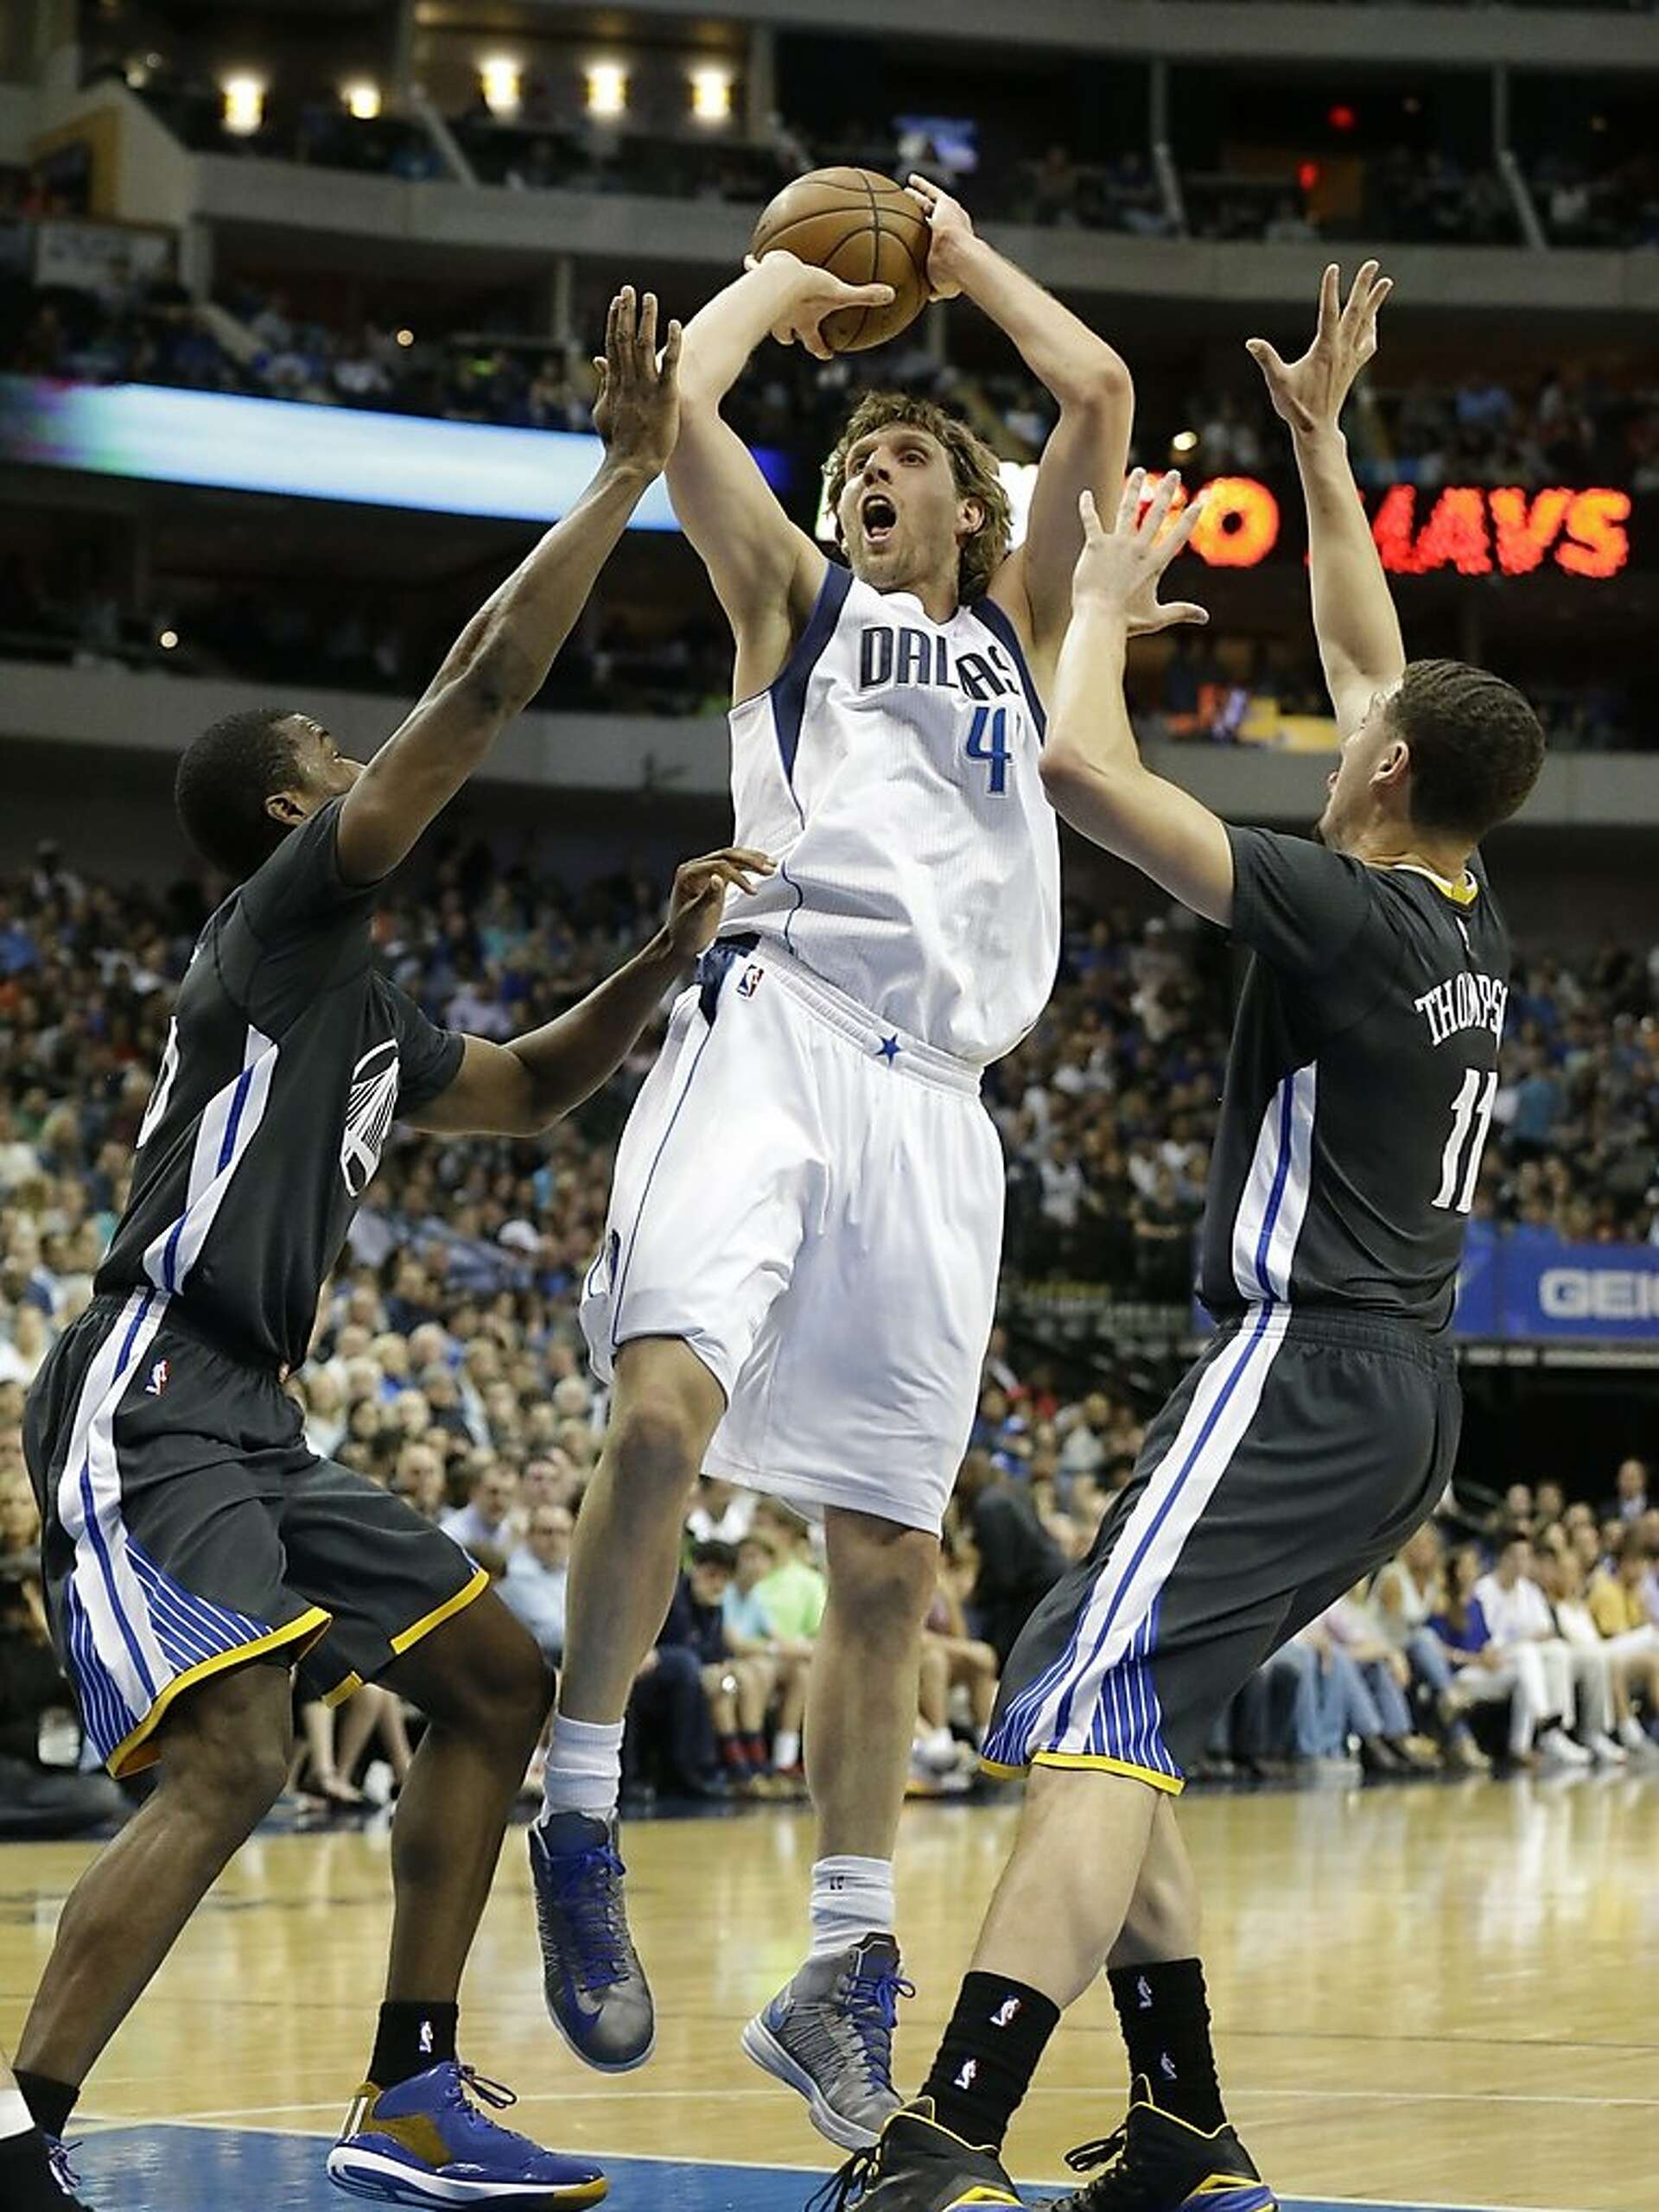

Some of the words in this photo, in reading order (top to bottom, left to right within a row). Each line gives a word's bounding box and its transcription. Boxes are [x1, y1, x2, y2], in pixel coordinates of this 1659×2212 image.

[860, 626, 1021, 701] DALAS
[1414, 971, 1508, 1051] THOMPS
[1431, 1068, 1498, 1213] 11
[1539, 1268, 1659, 1319] GEI
